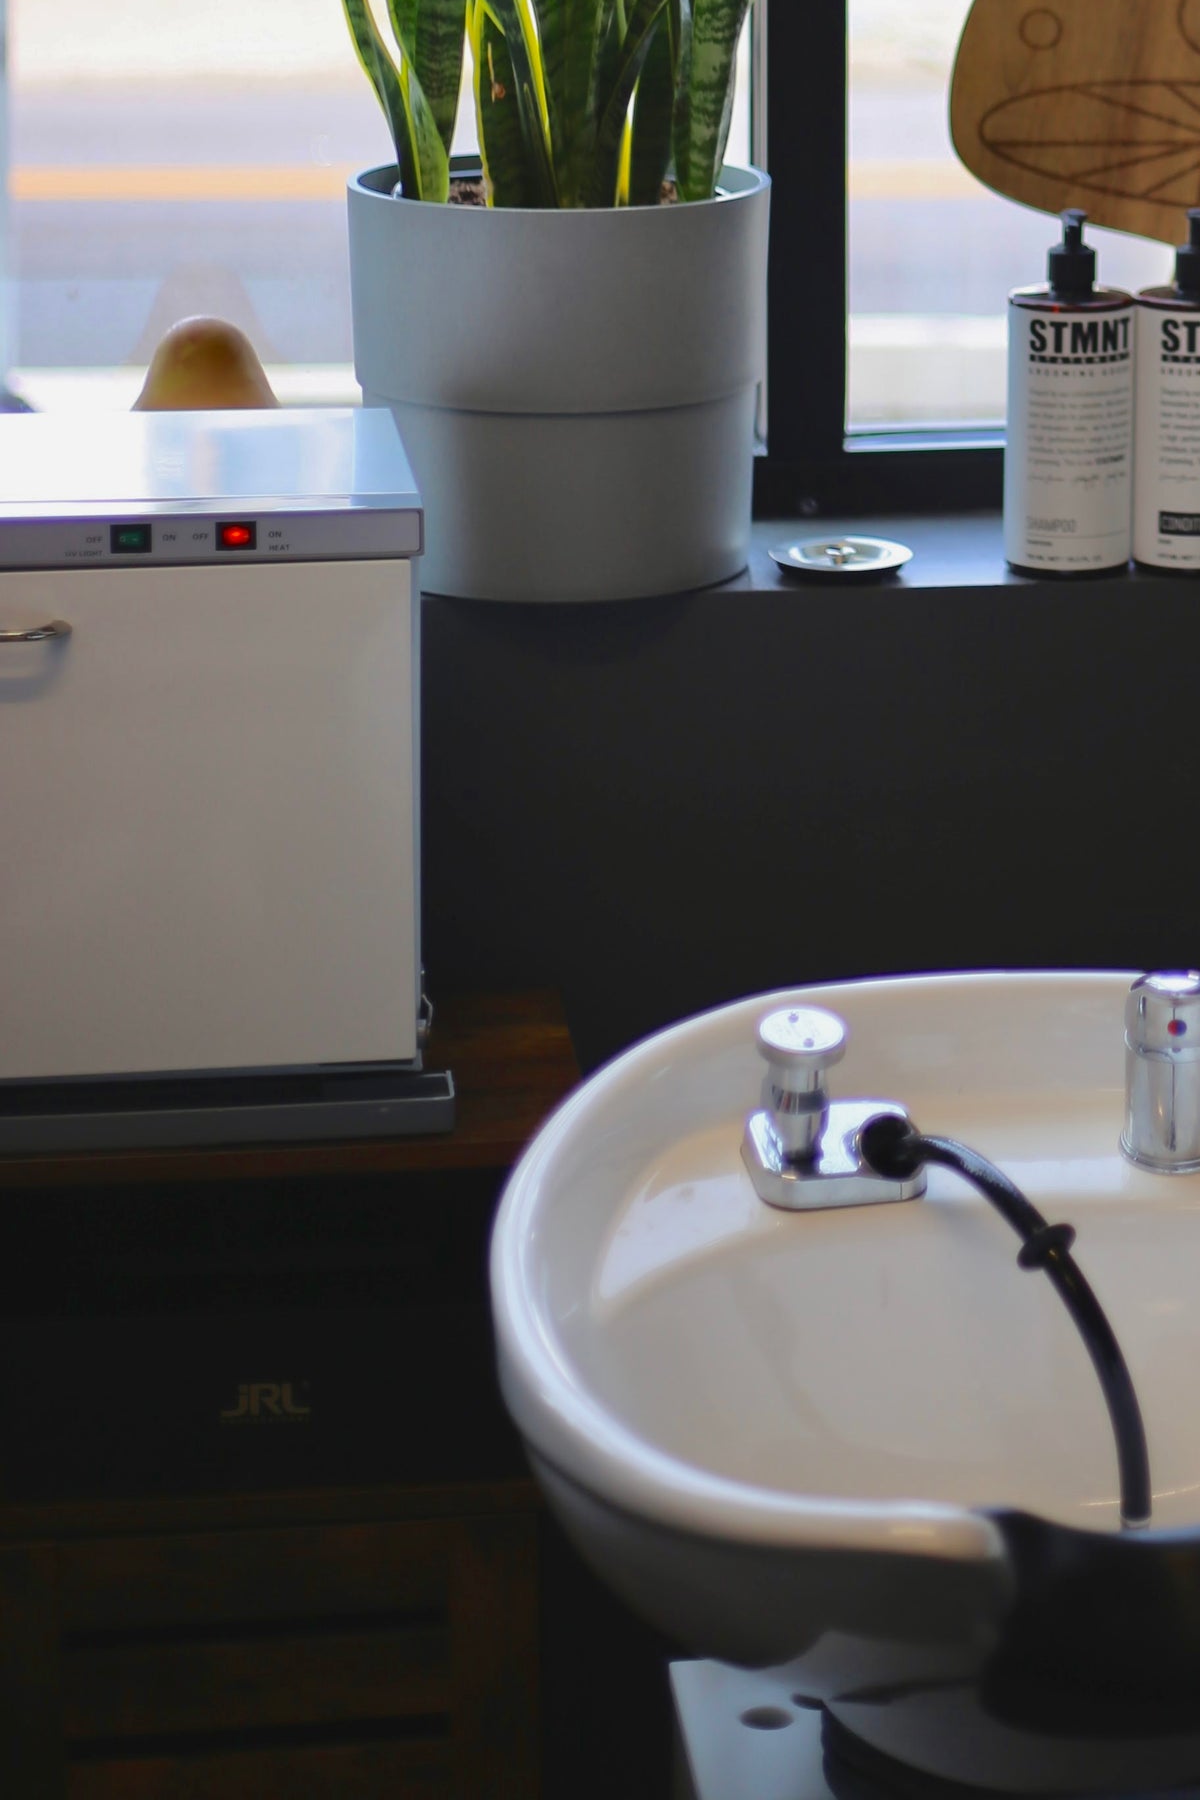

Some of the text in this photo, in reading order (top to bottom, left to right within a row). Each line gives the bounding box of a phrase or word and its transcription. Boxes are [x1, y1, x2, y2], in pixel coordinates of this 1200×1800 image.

[1029, 317, 1130, 353] STMNT
[1026, 515, 1077, 533] SHAMPOO
[162, 533, 177, 542] ON
[192, 532, 209, 541] OFF
[268, 530, 282, 539] ON
[85, 535, 104, 545] OFF
[269, 543, 290, 552] HEAT
[220, 1383, 311, 1417] JRL
